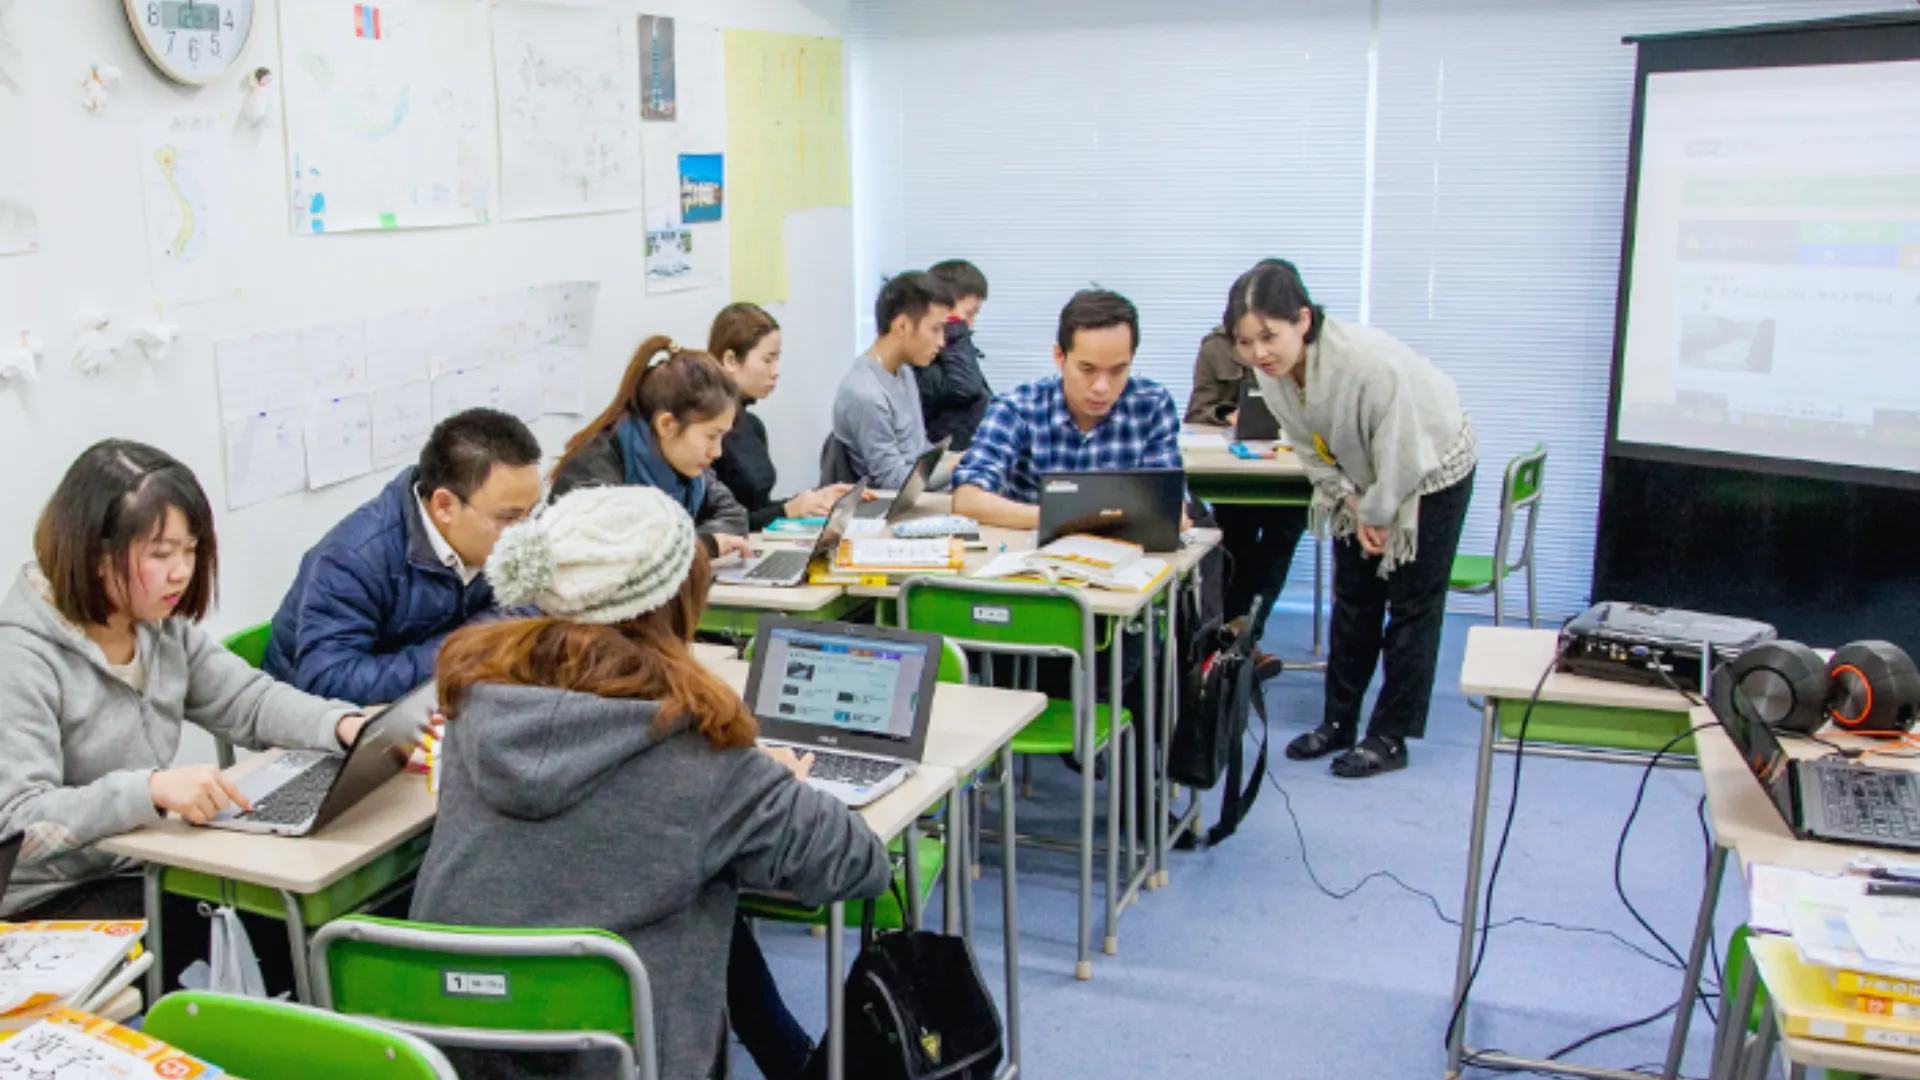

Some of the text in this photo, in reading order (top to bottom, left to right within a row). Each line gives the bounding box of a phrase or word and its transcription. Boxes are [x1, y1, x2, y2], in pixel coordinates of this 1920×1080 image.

[148, 2, 159, 26] 8
[223, 8, 234, 31] 4
[164, 30, 176, 56] 7
[188, 36, 200, 62] 6
[210, 33, 222, 59] 5
